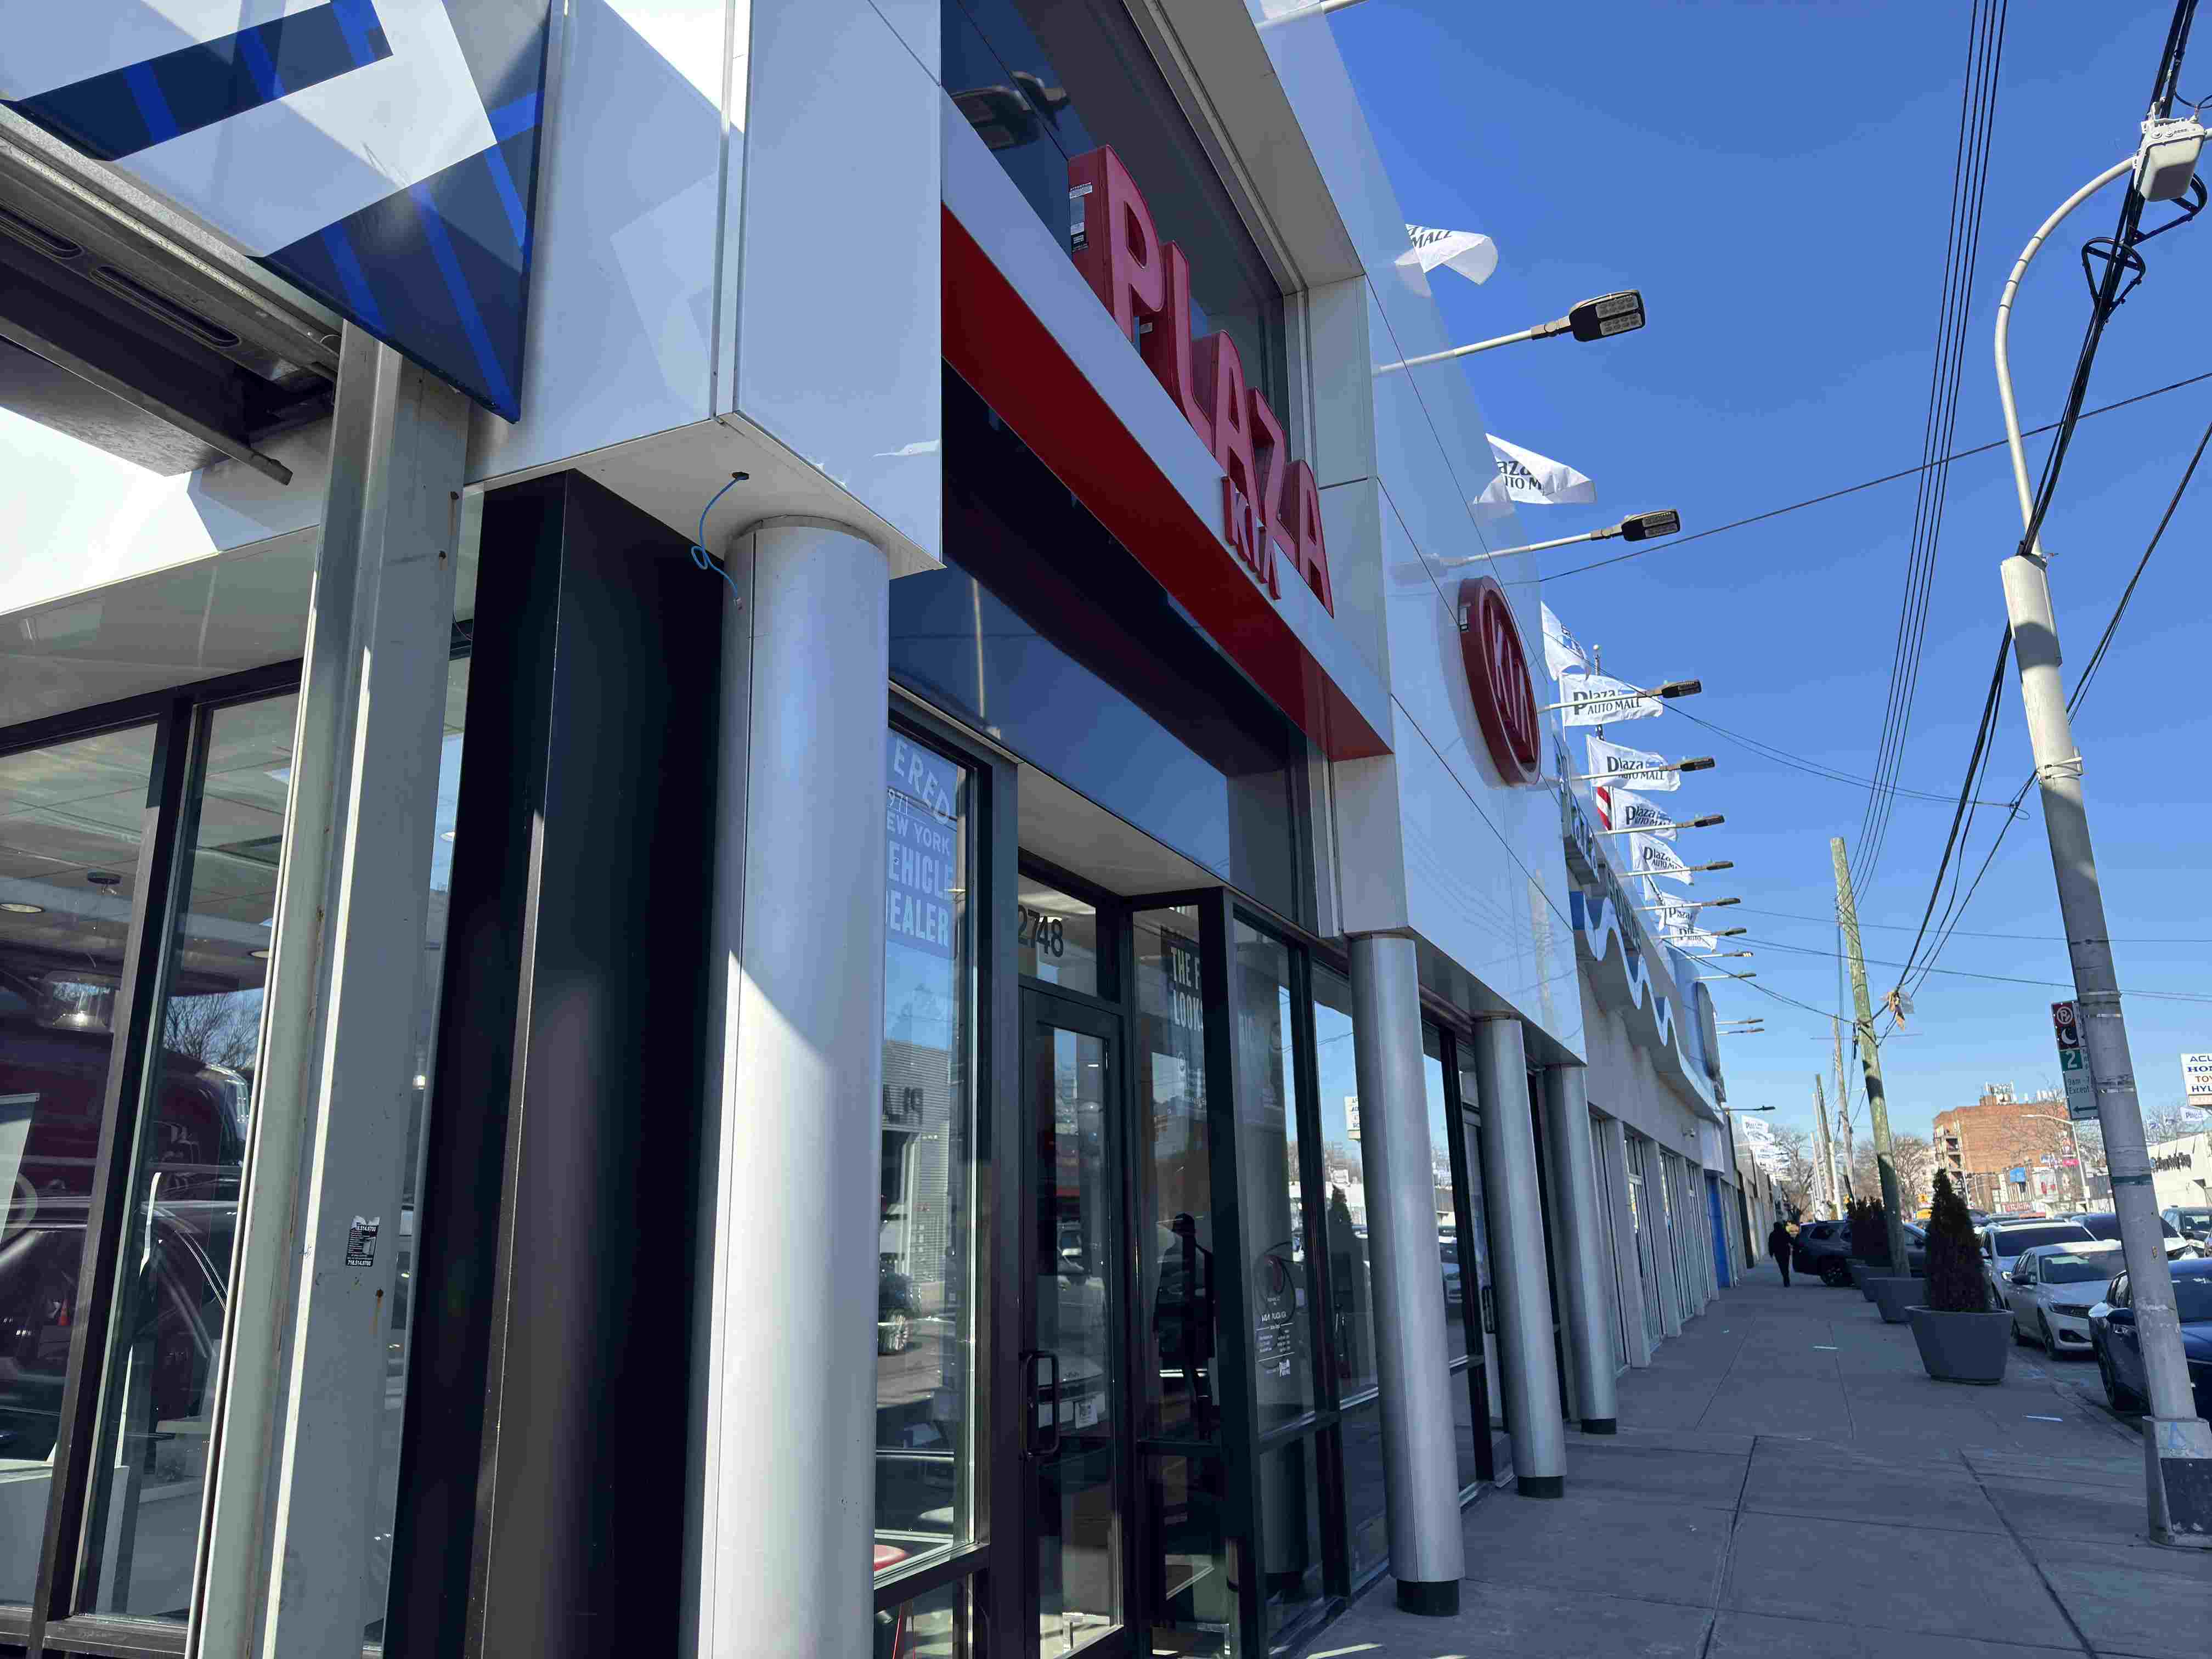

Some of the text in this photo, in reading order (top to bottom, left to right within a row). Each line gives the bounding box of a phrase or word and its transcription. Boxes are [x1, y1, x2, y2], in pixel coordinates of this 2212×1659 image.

[1070, 144, 1334, 619] PLAZA
[1573, 689, 1616, 715] Plaza
[1587, 697, 1642, 715] AUTO MALL
[1606, 756, 1644, 773] Plaza
[1641, 770, 1664, 780] MALL
[1625, 805, 1657, 825] Plaza
[913, 822, 951, 856] YORK
[885, 889, 949, 947] EALER
[1170, 946, 1192, 988] THE
[2065, 1049, 2078, 1069] 2
